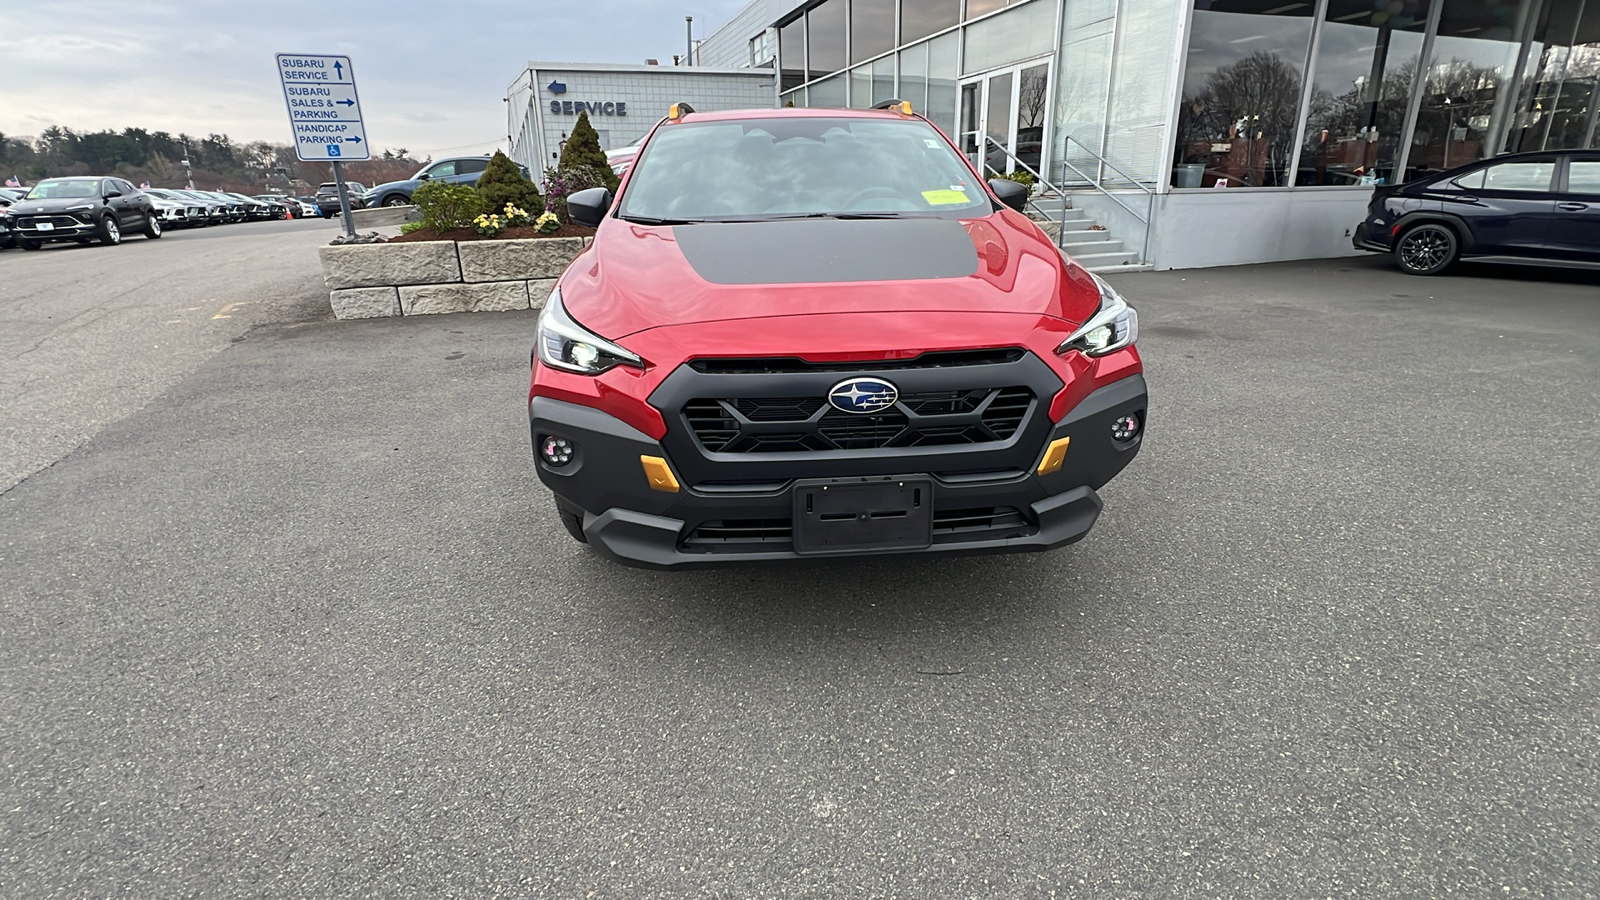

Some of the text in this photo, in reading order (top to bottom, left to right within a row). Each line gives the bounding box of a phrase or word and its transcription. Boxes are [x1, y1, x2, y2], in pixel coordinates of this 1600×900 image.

[282, 59, 325, 69] SUBARU
[284, 71, 328, 80] SERVICE
[288, 87, 331, 96] SUBARU
[291, 99, 334, 107] SALES &
[550, 100, 627, 116] SERVICE
[293, 110, 338, 119] PARKING
[297, 124, 348, 133] HANDICAP
[299, 135, 344, 144] PARKING
